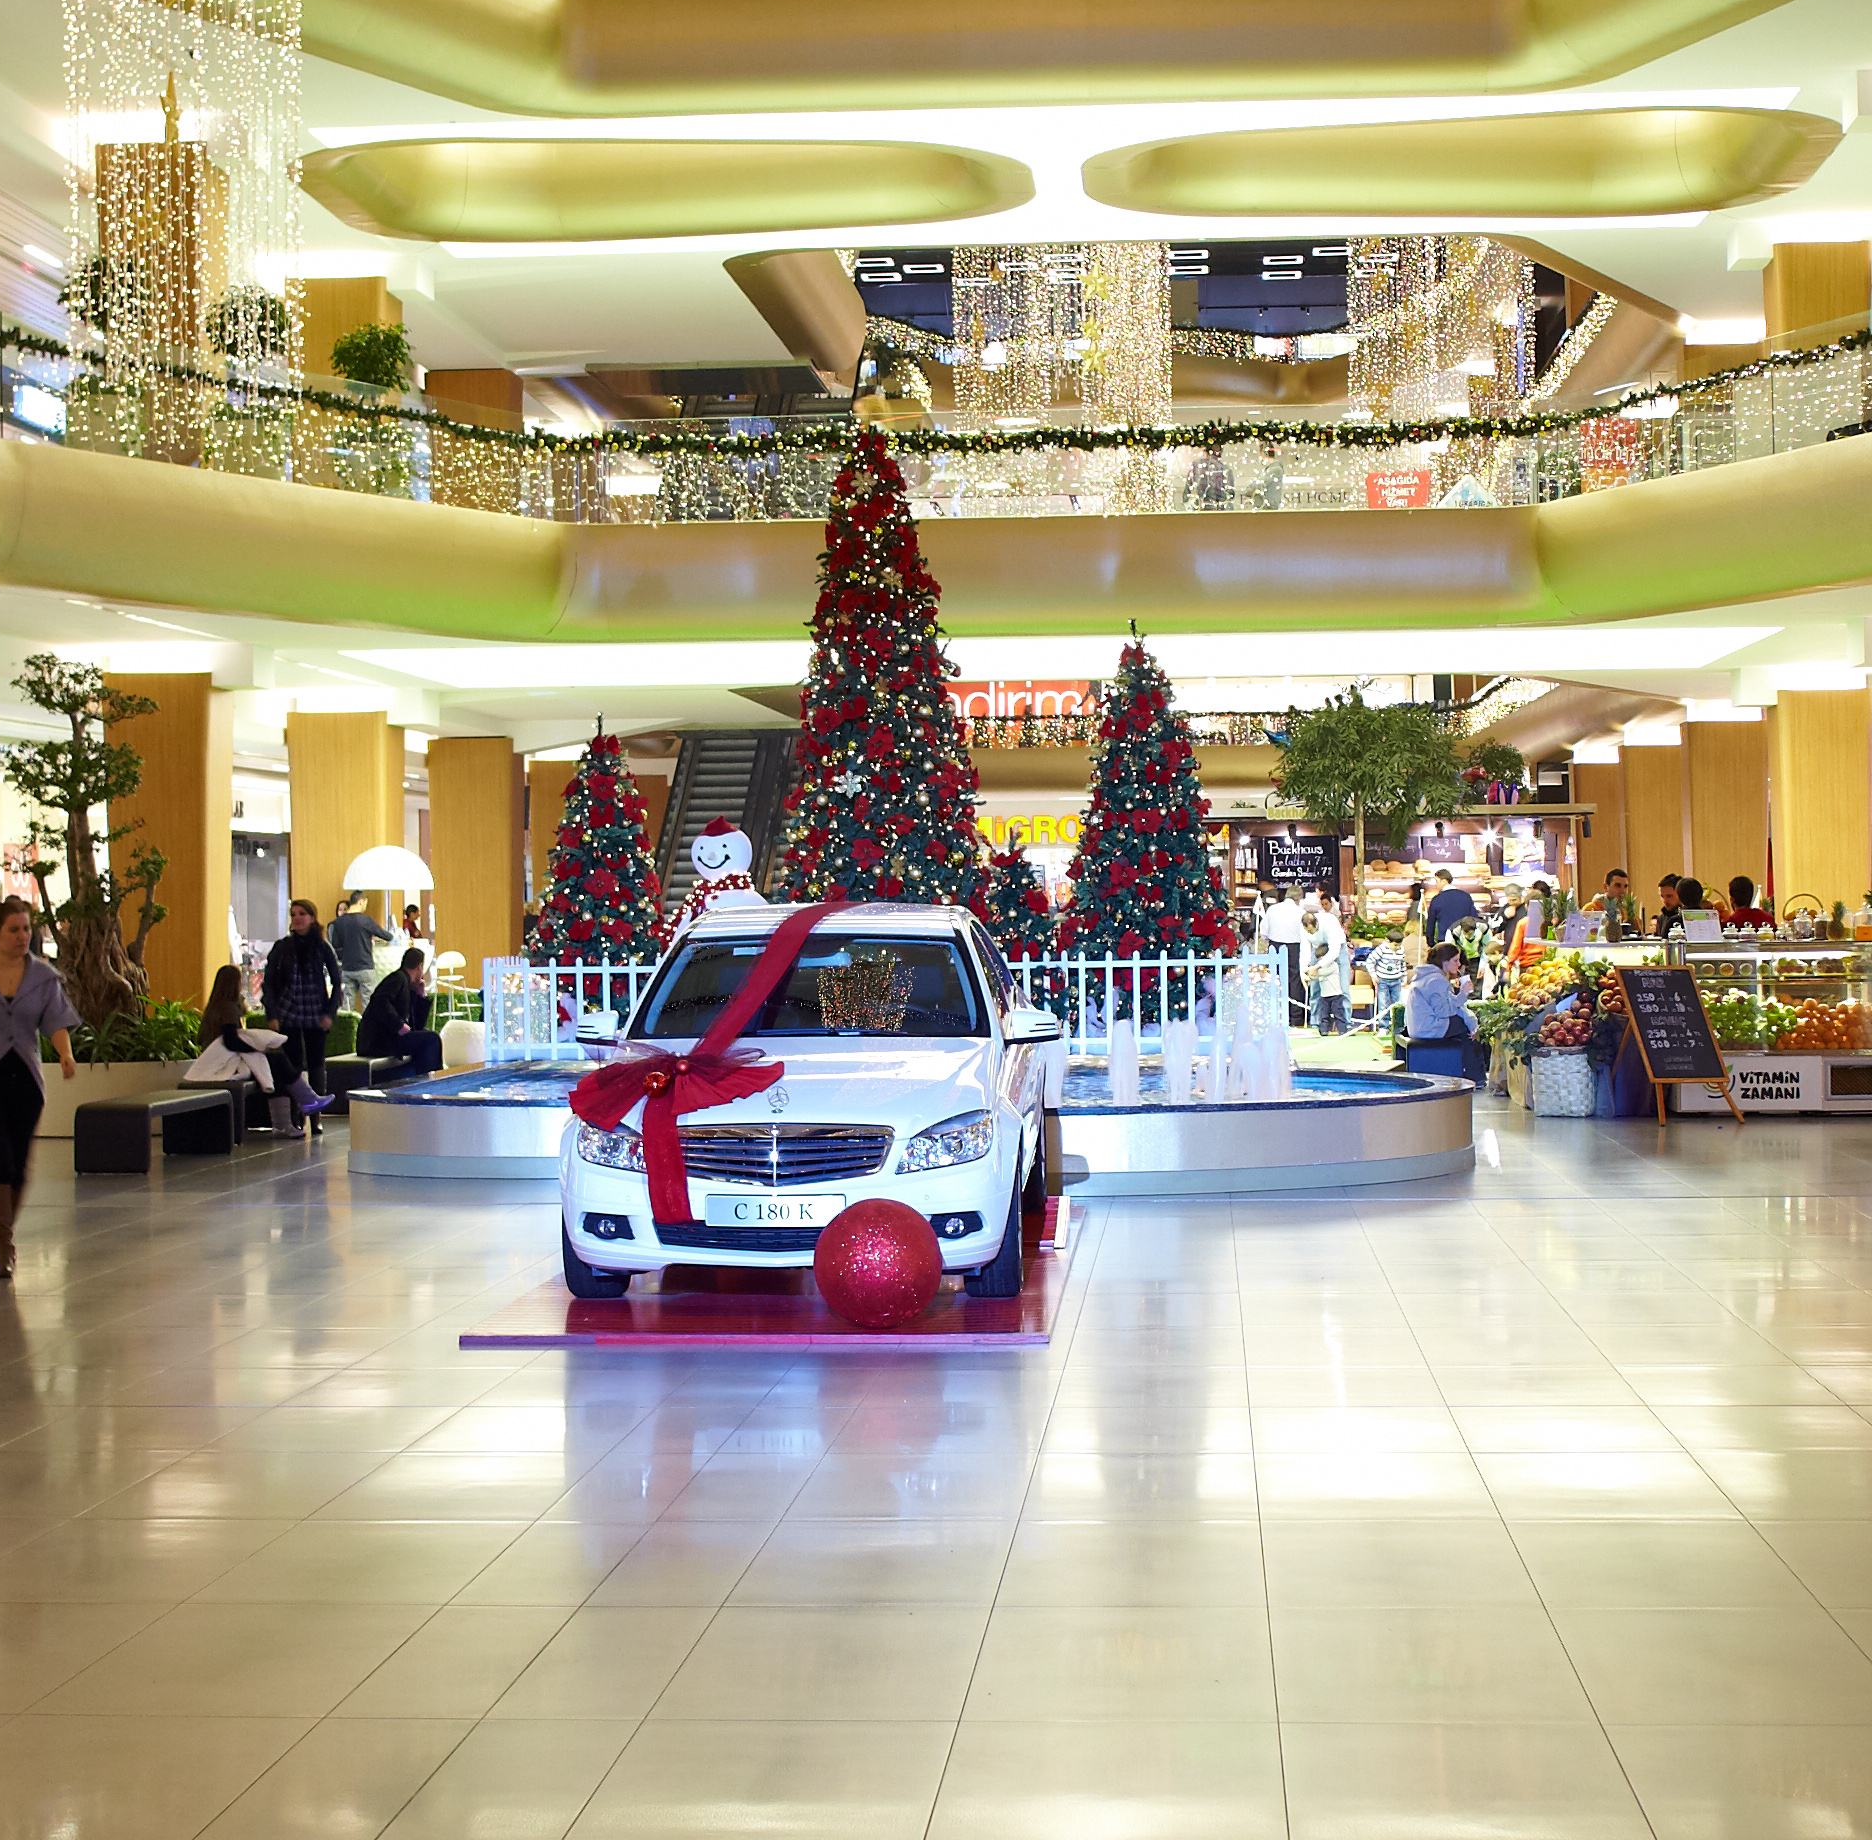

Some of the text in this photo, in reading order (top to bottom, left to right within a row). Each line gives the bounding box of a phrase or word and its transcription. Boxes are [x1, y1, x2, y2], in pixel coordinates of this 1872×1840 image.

[946, 680, 1084, 717] ndirim
[977, 814, 1085, 844] MiGRO
[1268, 840, 1324, 855] Backhaus
[1650, 1040, 1671, 1048] 500
[1740, 1086, 1801, 1100] ZAMANI
[734, 1203, 813, 1220] C 180 K
